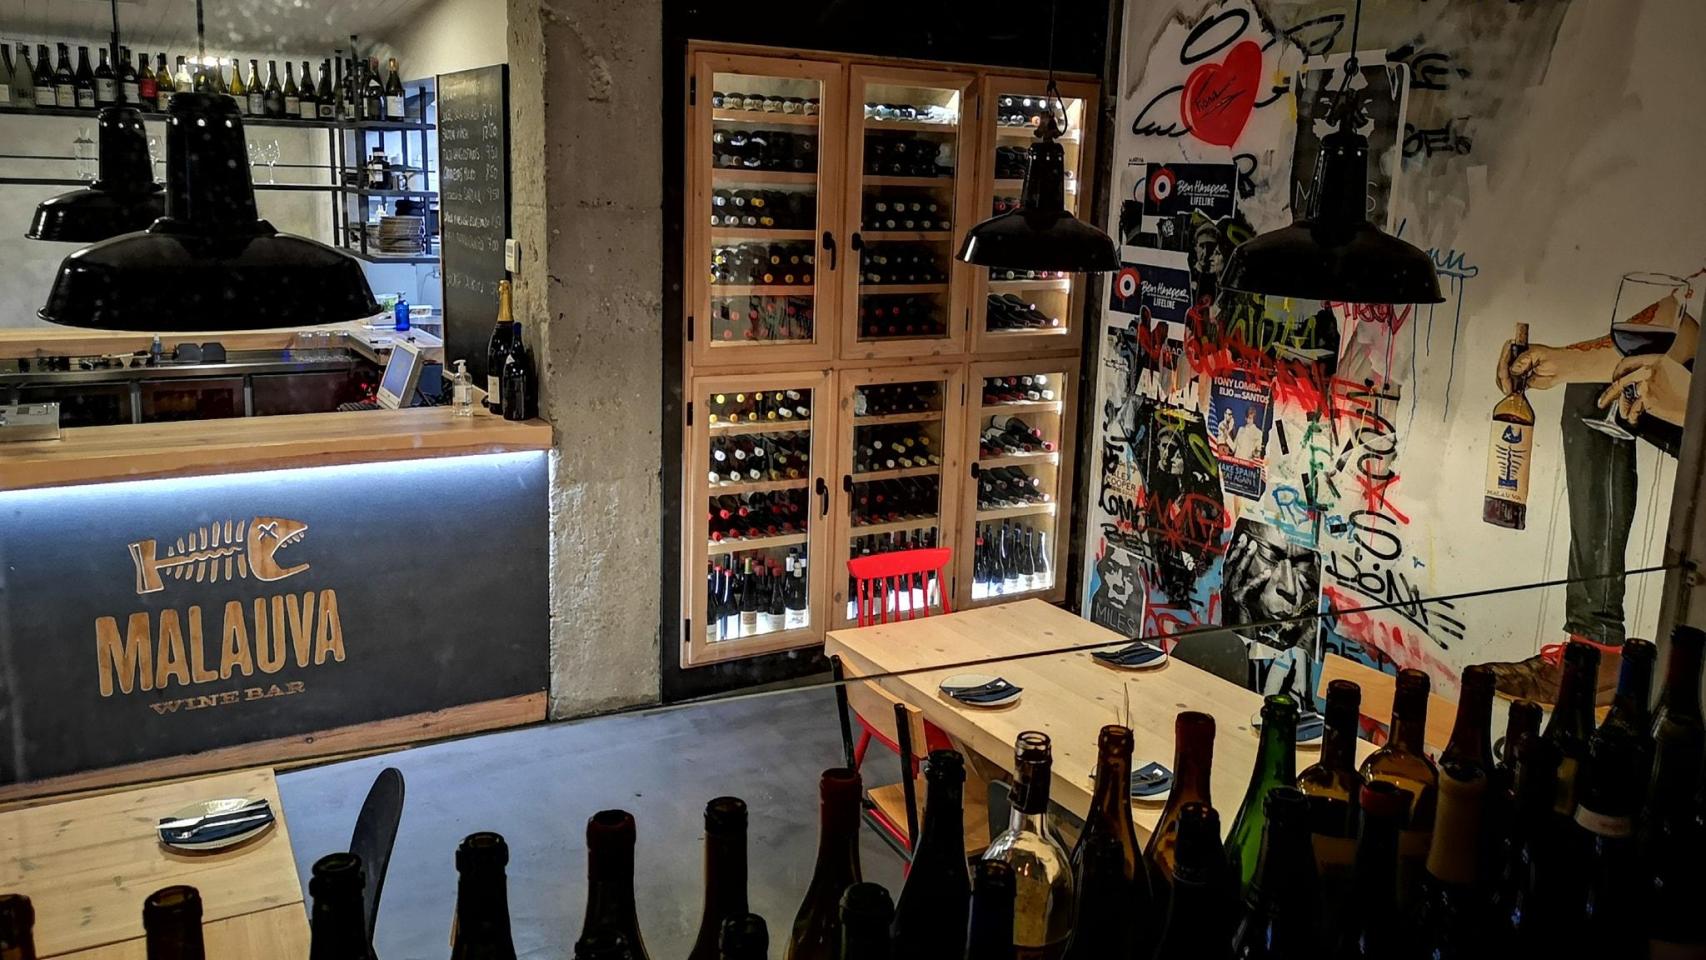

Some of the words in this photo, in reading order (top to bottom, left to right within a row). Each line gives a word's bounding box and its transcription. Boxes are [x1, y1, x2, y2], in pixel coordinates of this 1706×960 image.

[1190, 196, 1215, 206] LIFELINE
[1153, 297, 1176, 310] LIFELINE
[1214, 376, 1235, 387] TONY
[1241, 391, 1270, 405] SANTOS
[1095, 602, 1136, 637] MILES
[95, 588, 345, 697] MALAUVA
[150, 690, 240, 715] WINE
[244, 681, 306, 701] BAR
